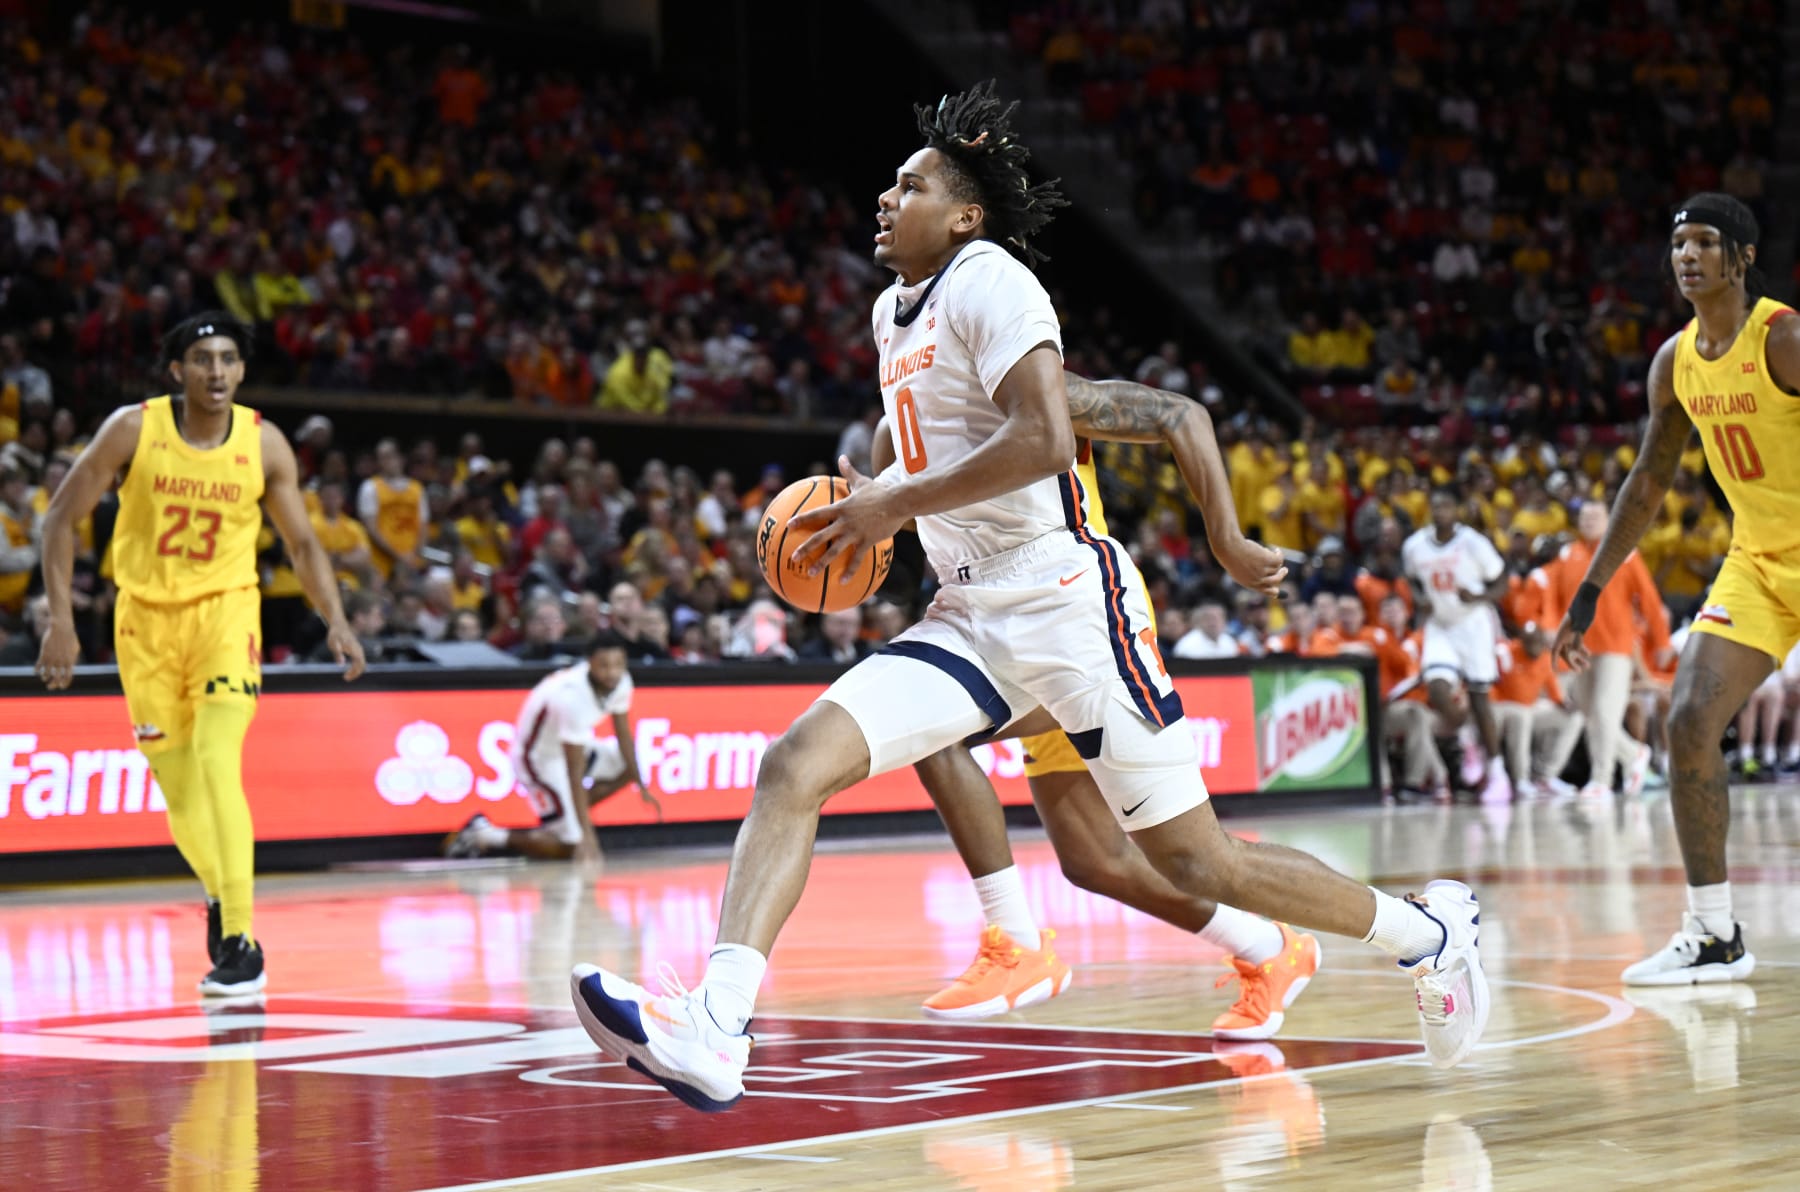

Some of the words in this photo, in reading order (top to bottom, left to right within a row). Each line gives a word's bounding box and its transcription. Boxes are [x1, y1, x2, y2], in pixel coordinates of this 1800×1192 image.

[880, 344, 937, 389] LLINOIS
[896, 386, 928, 476] 0
[1688, 392, 1758, 418] MARYLAND
[1711, 422, 1766, 483] 10
[153, 474, 242, 504] MARYLAND
[157, 503, 222, 563] 23
[634, 716, 769, 794] Farm
[1257, 686, 1362, 784] LIBMAN
[0, 732, 168, 820] Farm
